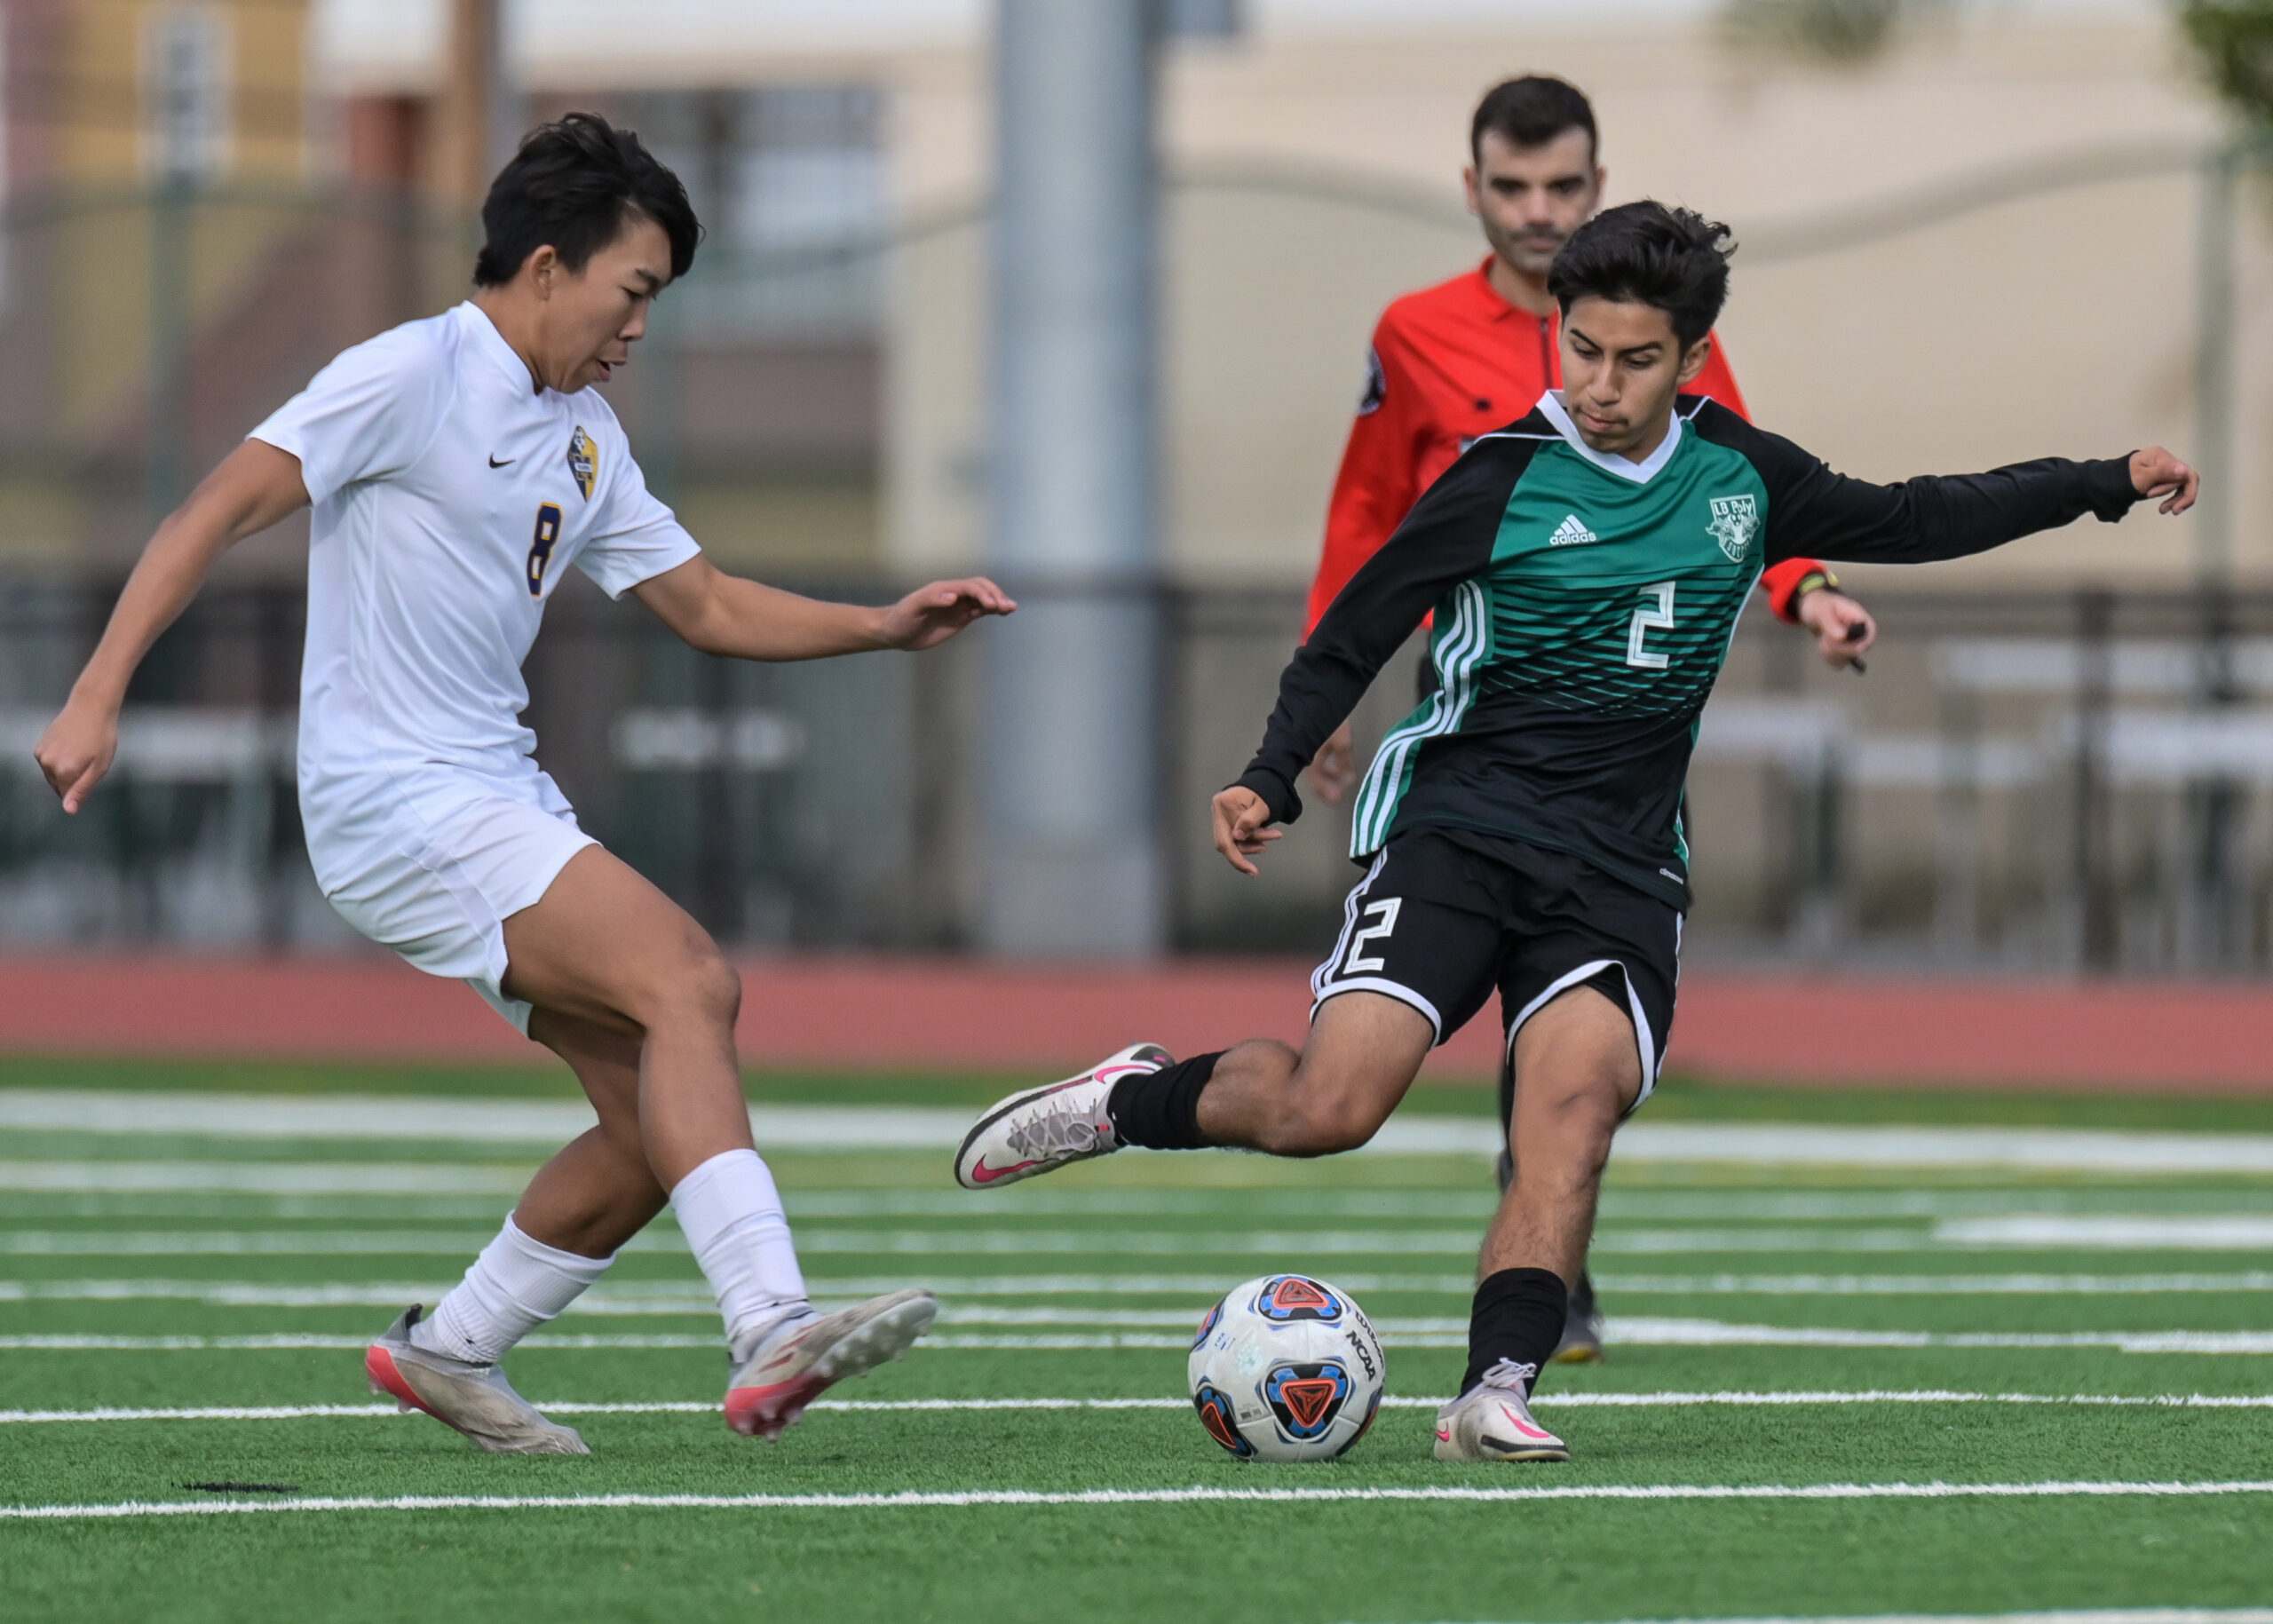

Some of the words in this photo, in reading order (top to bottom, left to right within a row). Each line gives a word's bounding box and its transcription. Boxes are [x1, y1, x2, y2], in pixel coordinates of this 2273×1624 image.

[1549, 531, 1596, 546] adidas
[1714, 502, 1729, 515] LB
[1730, 500, 1752, 517] Poly
[527, 502, 562, 598] 8
[1627, 582, 1675, 668] 2
[1343, 897, 1402, 975] 2
[1346, 1329, 1376, 1382] NCAA
